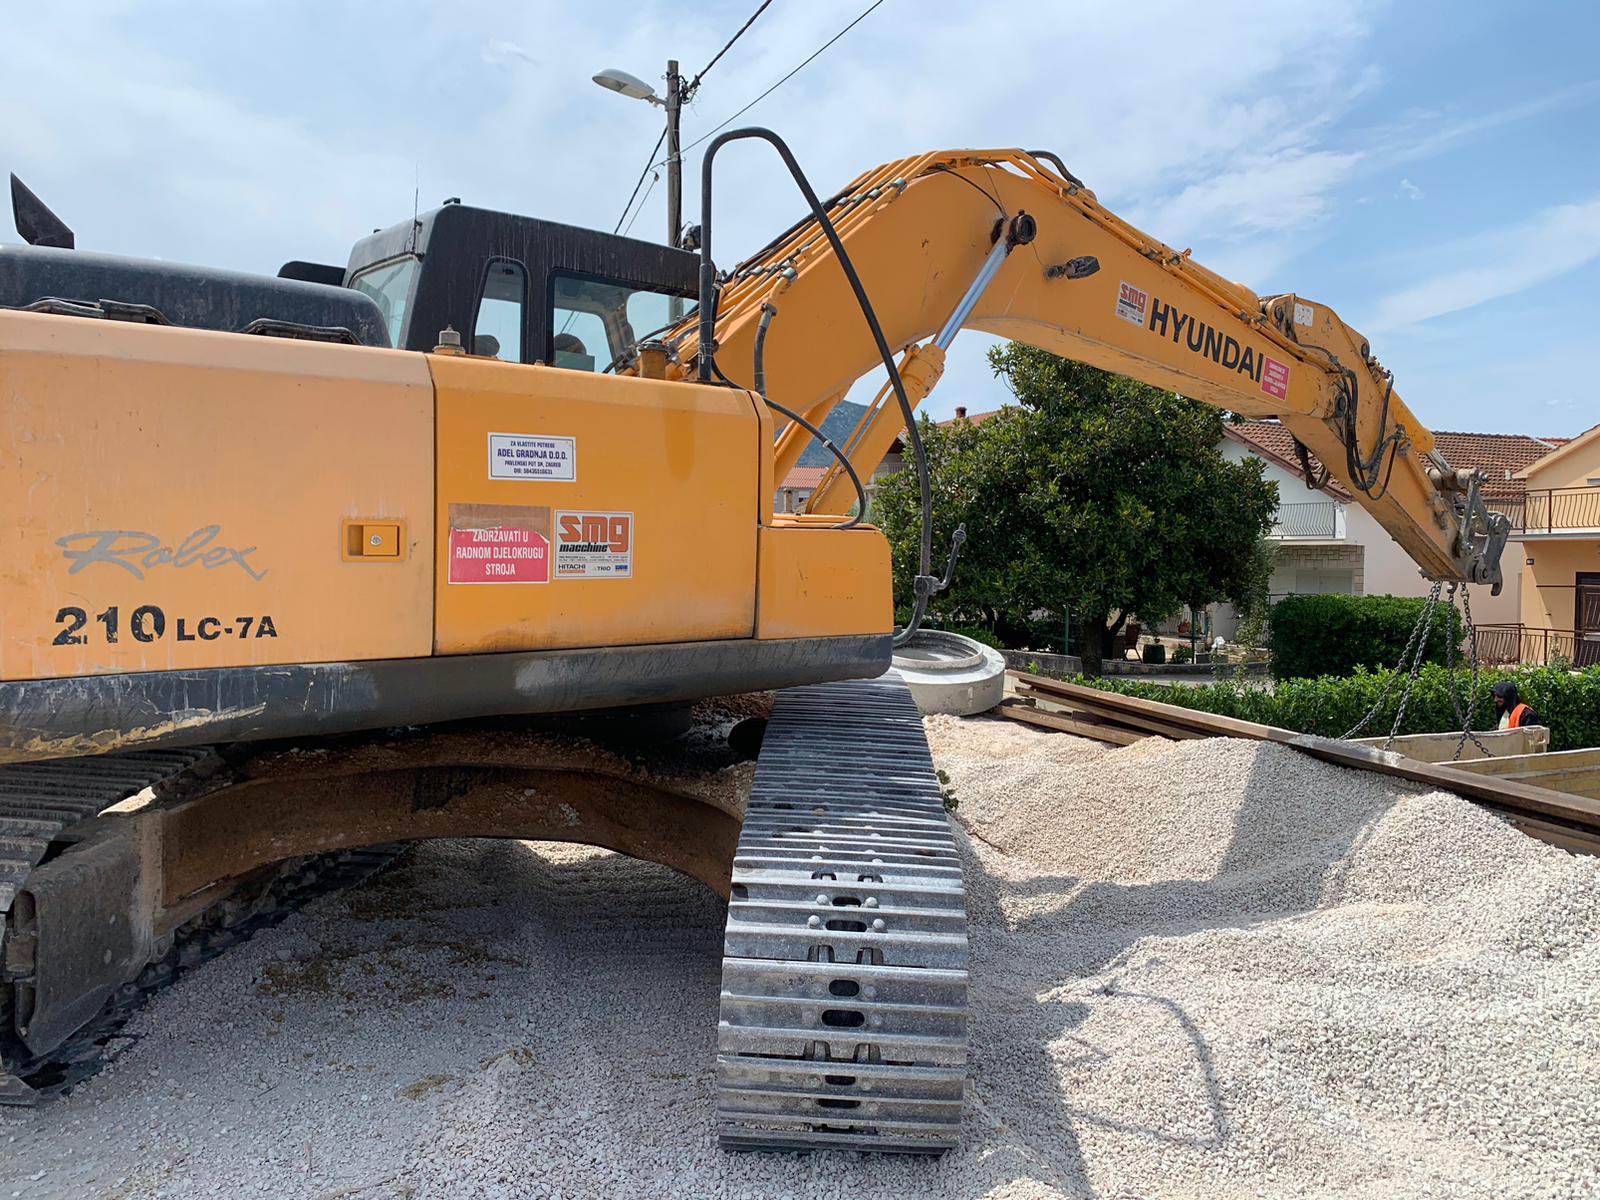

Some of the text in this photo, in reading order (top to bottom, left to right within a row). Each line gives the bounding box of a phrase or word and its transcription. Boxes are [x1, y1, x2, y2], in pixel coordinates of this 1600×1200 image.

[1149, 297, 1264, 383] HYUNDAI
[497, 448, 567, 460] ADEL GRADNJA D.O.O.
[523, 530, 529, 542] U
[558, 515, 630, 553] smg
[55, 523, 269, 581] Robex
[456, 547, 544, 559] RADNOM DJELOKRUGU
[559, 542, 609, 553] macchine
[485, 563, 516, 576] STROJA
[52, 604, 278, 646] 210 LC-7A
